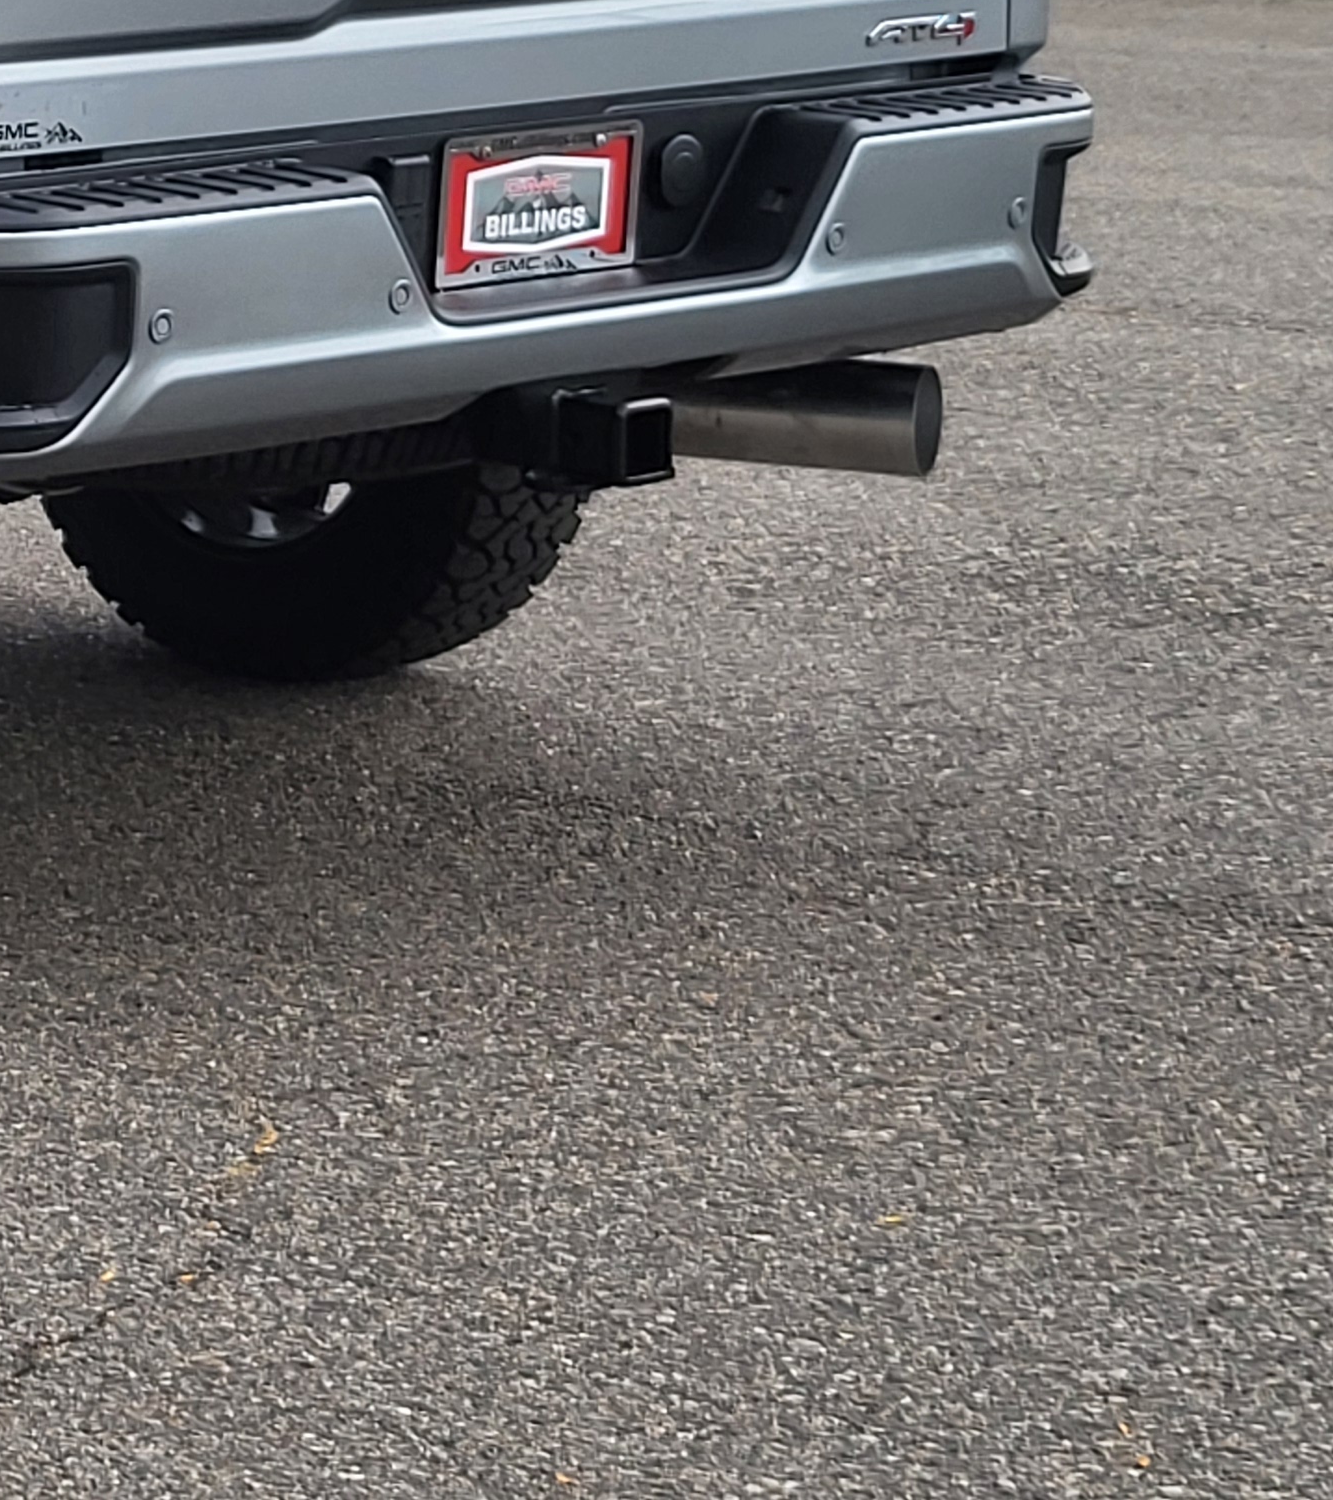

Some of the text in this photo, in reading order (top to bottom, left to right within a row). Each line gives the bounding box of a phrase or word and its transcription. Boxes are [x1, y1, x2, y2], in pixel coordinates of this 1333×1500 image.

[865, 9, 976, 47] AT4
[504, 173, 572, 197] GMC
[485, 205, 586, 239] BILLINGS
[491, 256, 542, 274] GMC
